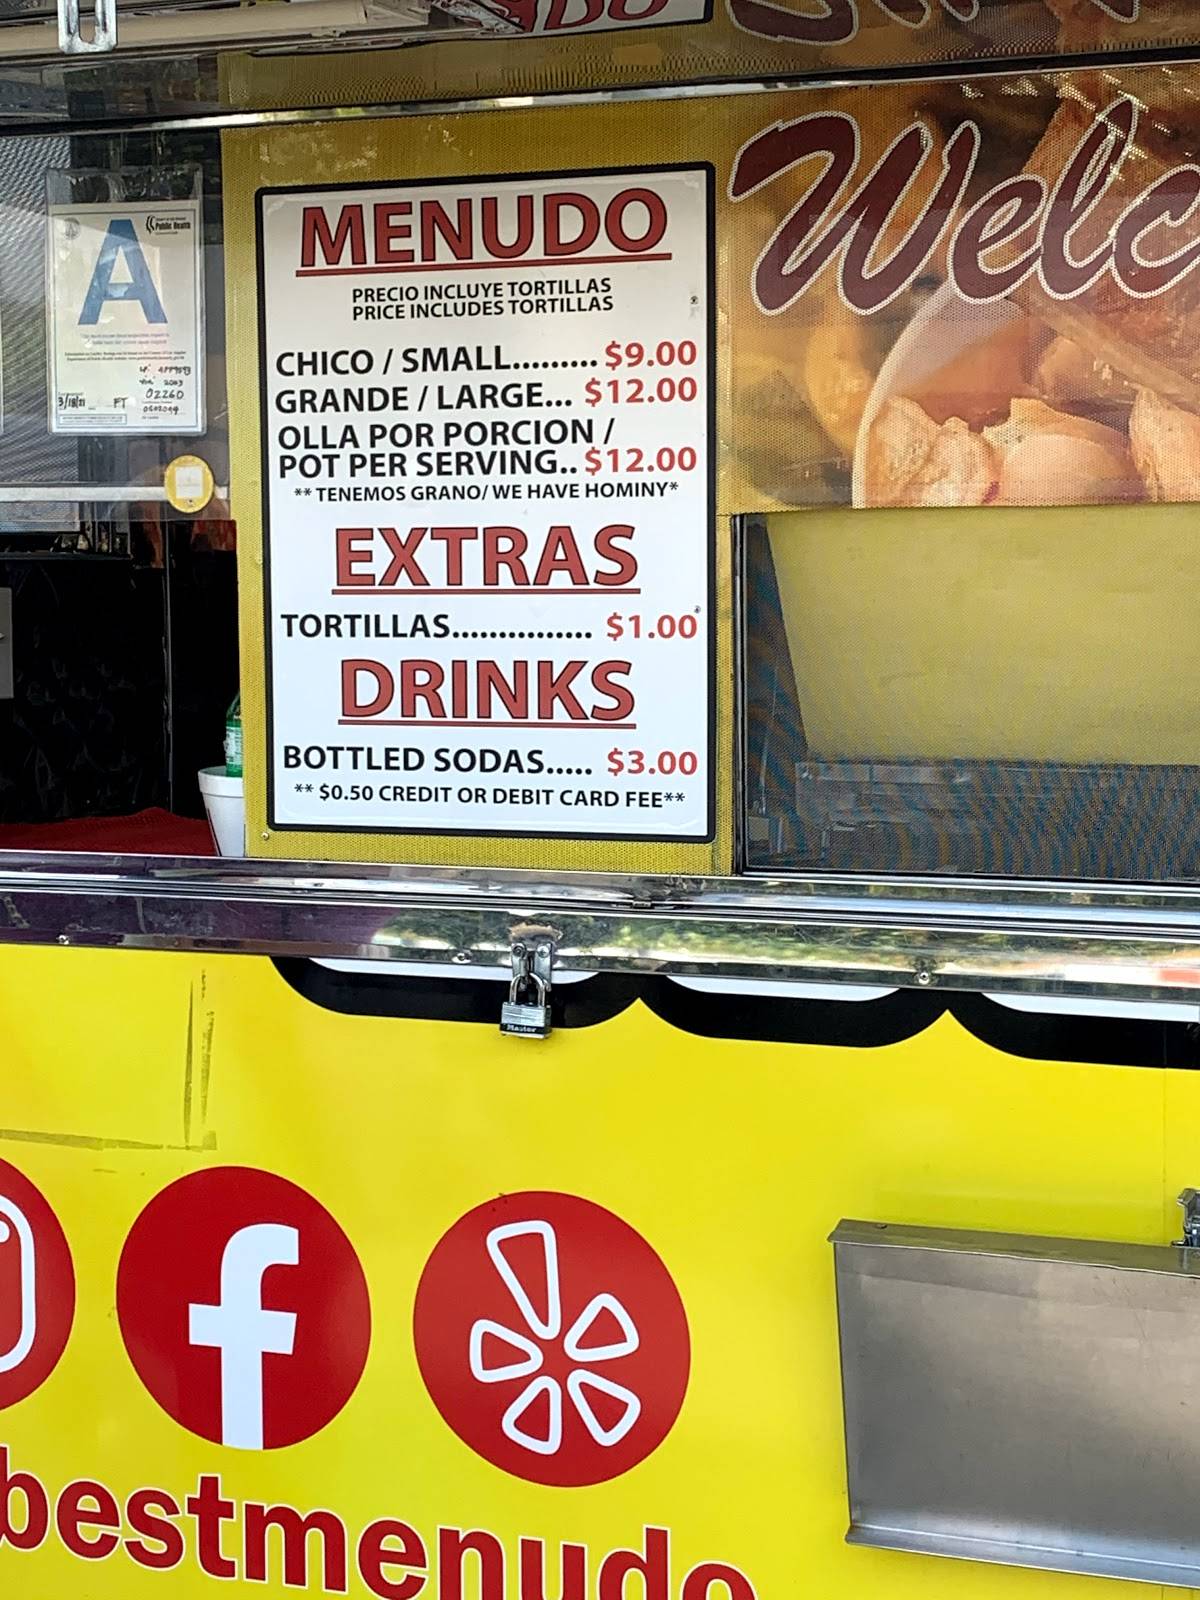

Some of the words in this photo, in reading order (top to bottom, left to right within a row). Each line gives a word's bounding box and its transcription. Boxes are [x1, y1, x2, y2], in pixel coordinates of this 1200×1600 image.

[300, 187, 668, 268] MENUDO
[78, 219, 167, 325] A
[352, 286, 419, 304] PRECIO
[423, 282, 504, 301] INCLUYE
[506, 277, 612, 297] TORTILLAS
[352, 304, 406, 321] PRICE
[410, 300, 505, 319] INCLUDES
[507, 295, 614, 315] TORTILLAS
[275, 349, 374, 377] CHICO
[382, 348, 394, 375] /
[604, 340, 698, 371] $9.00
[275, 386, 409, 414] GRANDE
[417, 385, 429, 412] /
[584, 376, 698, 407] $12.00
[278, 424, 360, 451] OLLA
[369, 422, 434, 449] POR
[444, 418, 593, 447] PORCION
[603, 417, 615, 445] /
[279, 453, 341, 479] POT
[349, 452, 407, 478] PER
[584, 446, 697, 476] $12.00
[315, 486, 406, 502] TENEMOS
[492, 484, 522, 500] WE
[527, 483, 580, 499] HAVE
[335, 524, 638, 587] EXTRAS
[606, 612, 698, 641] $1.00
[341, 658, 635, 722] DRINKS
[283, 745, 425, 772] BOTTLED
[606, 747, 698, 777] $3.00
[319, 783, 374, 801] $0.50
[378, 785, 453, 803] CREDIT
[457, 787, 487, 804] OR
[492, 788, 555, 805] DEBIT
[559, 789, 620, 807] CARD
